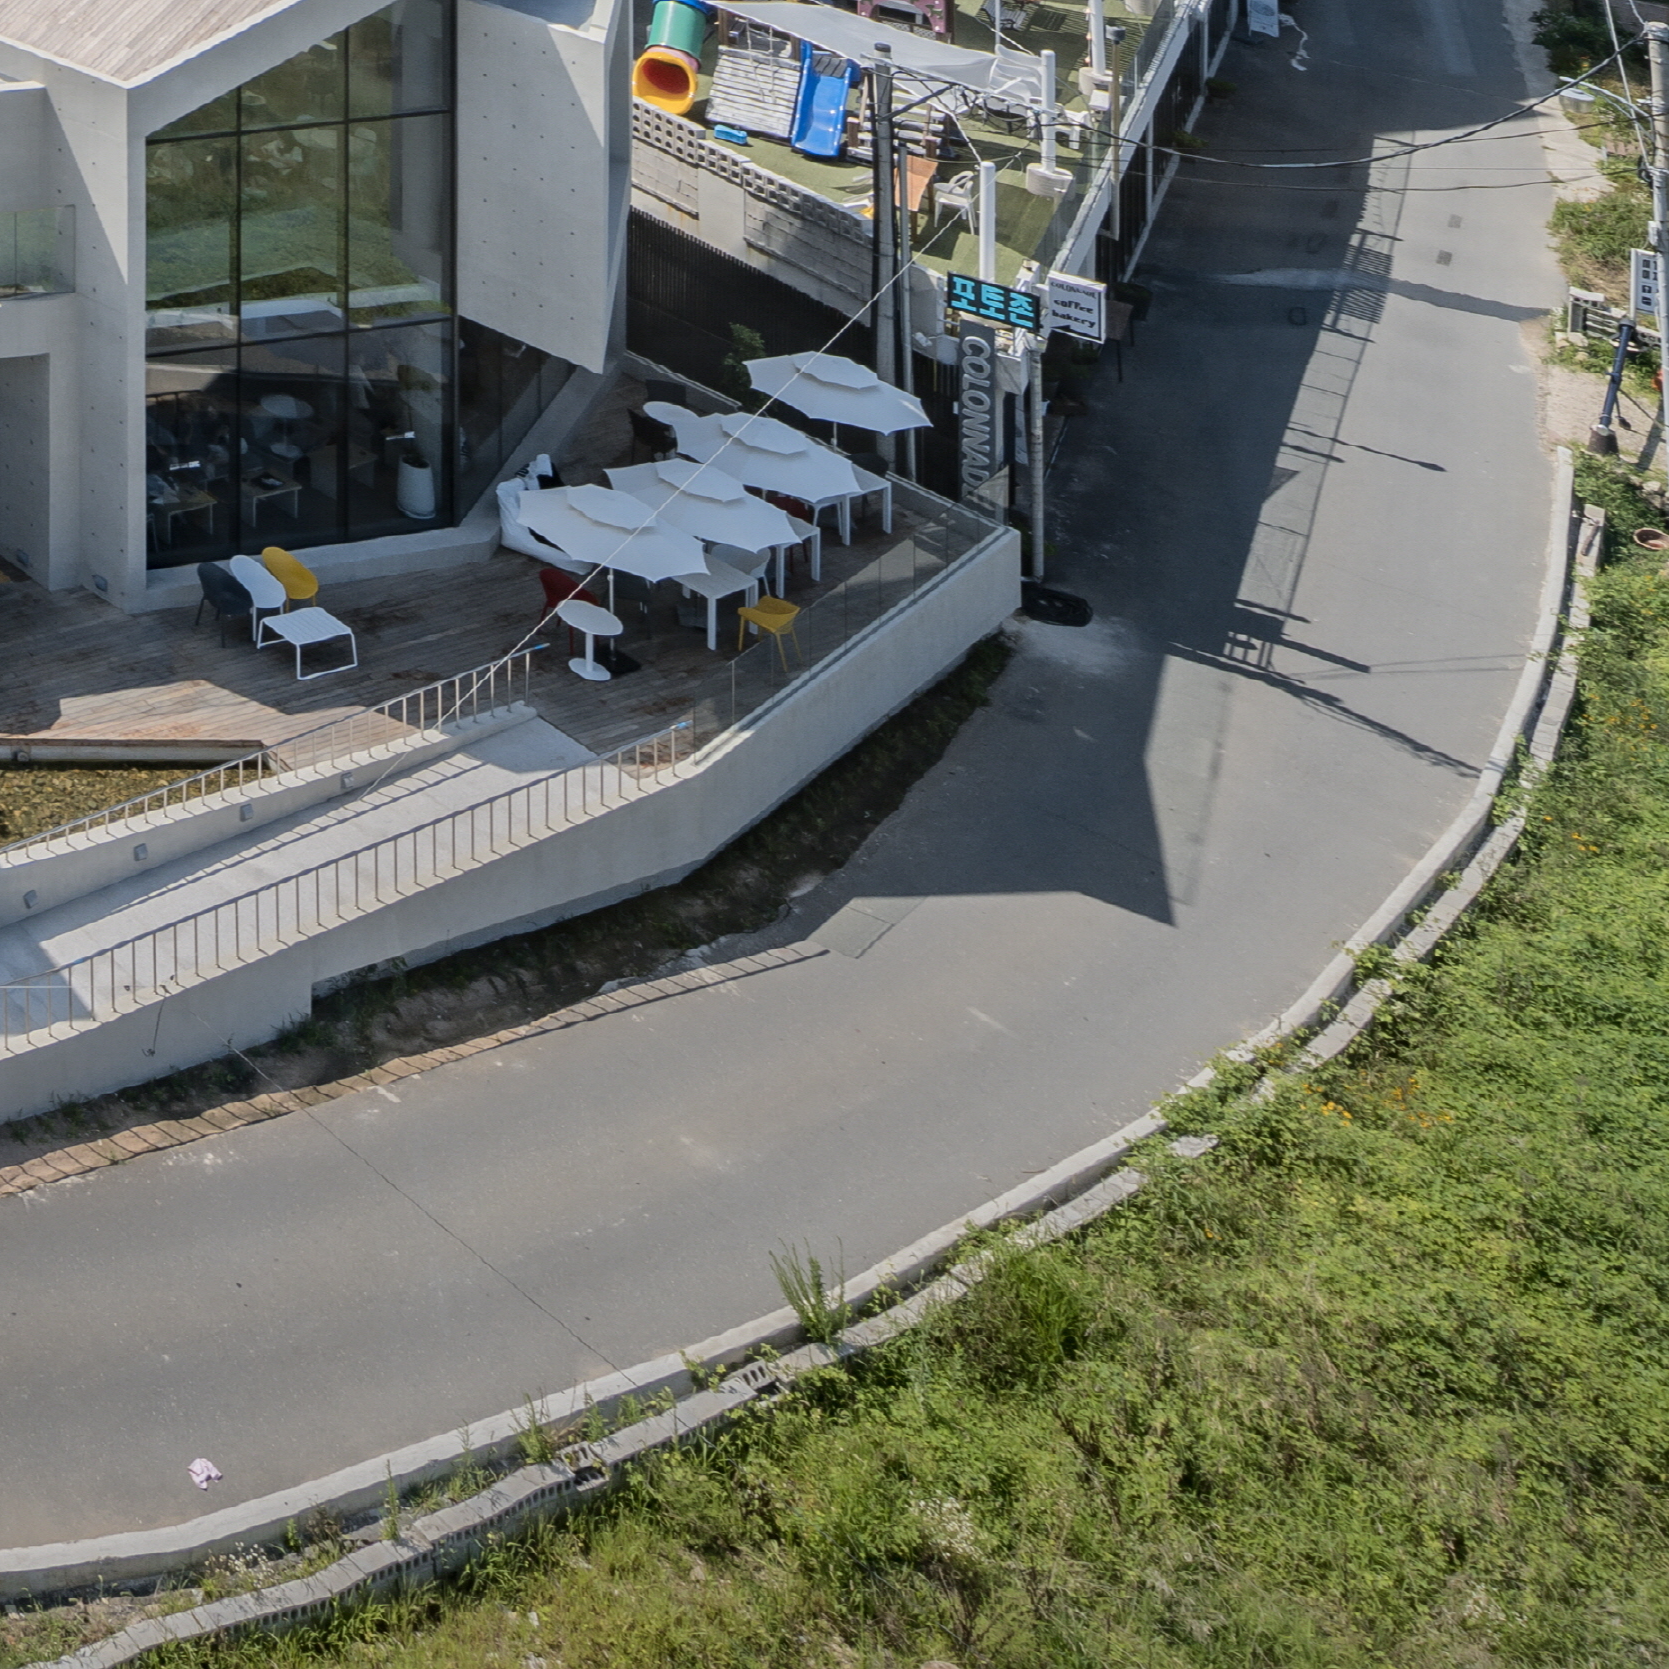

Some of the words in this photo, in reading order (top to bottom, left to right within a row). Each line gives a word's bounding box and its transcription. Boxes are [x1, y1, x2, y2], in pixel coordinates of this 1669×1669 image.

[950, 276, 1035, 328] 포토존
[1053, 298, 1094, 315] coffee
[1052, 309, 1096, 329] bakery
